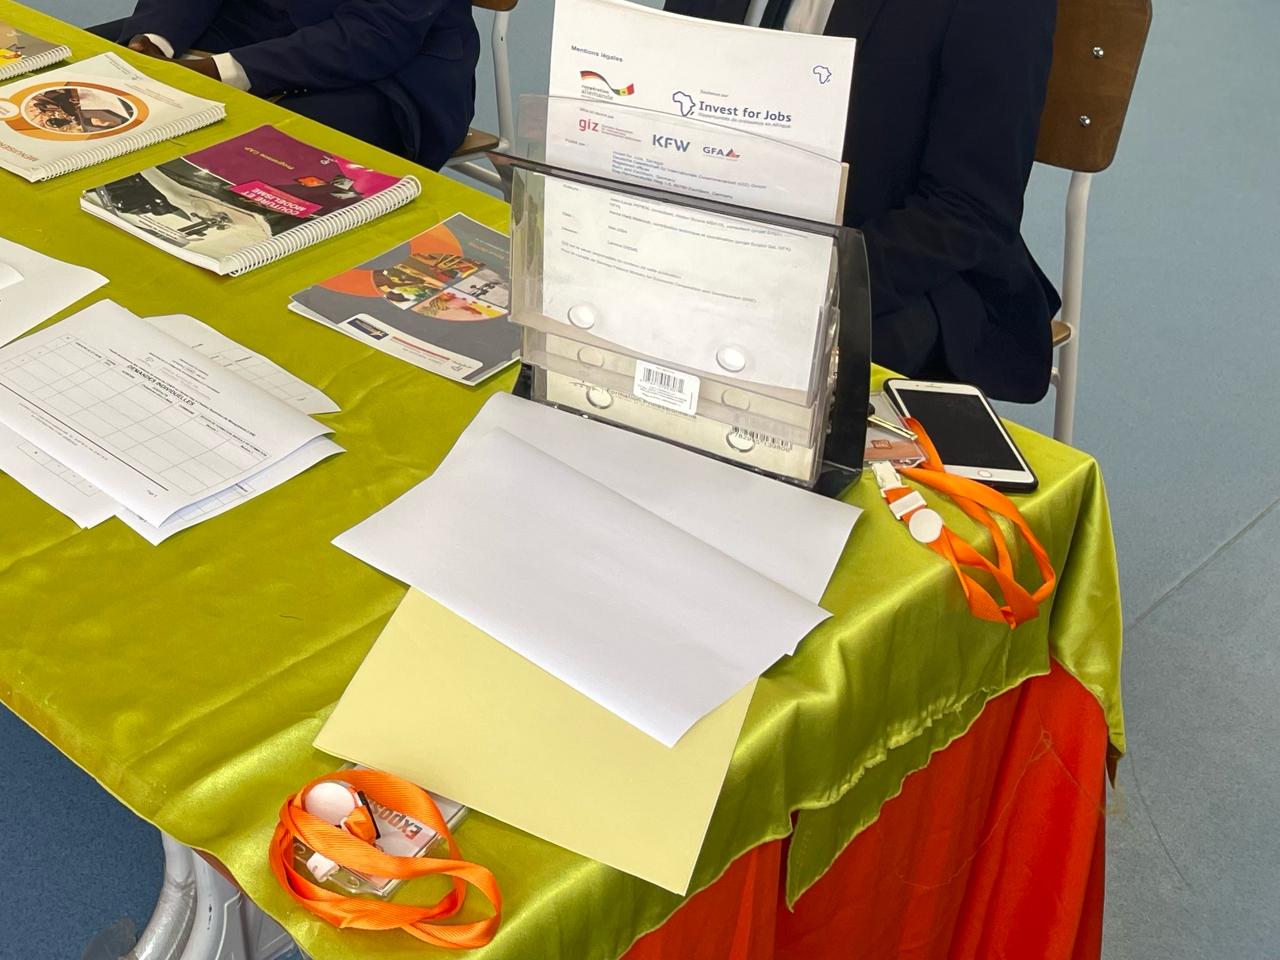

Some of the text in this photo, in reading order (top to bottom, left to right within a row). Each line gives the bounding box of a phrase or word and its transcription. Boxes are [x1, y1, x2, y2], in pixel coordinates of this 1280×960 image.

[571, 45, 623, 62] Mentions légales
[581, 89, 614, 100] allemande
[699, 101, 792, 122] Invest for Jobs
[579, 119, 599, 132] giz
[703, 146, 724, 157] GFA
[254, 197, 300, 216] COUTURE
[127, 364, 157, 384] DEMANDES
[156, 381, 195, 406] INDIVIDUELLES
[369, 801, 423, 840] Expos
